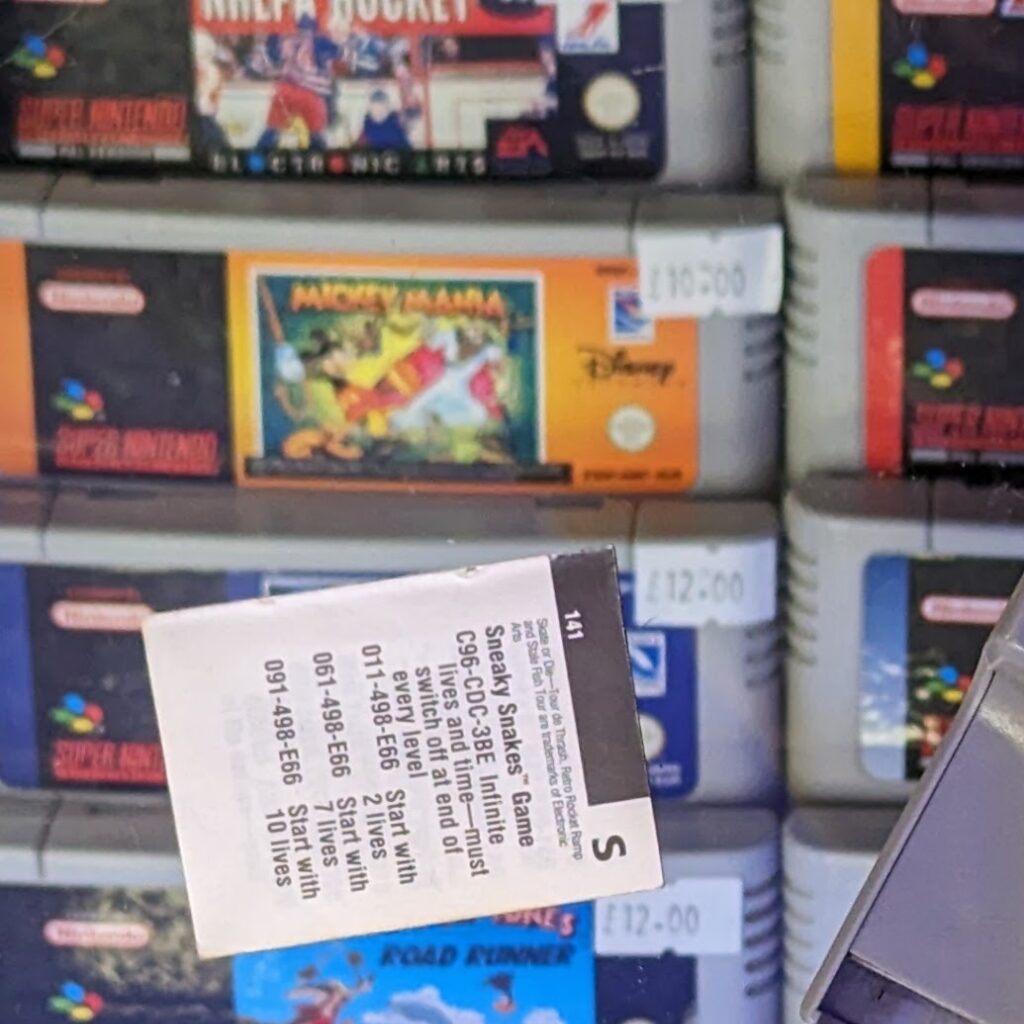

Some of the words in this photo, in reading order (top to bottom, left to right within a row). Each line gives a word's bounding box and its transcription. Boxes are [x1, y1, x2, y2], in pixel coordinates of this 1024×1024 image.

[511, 622, 522, 642] Arts
[524, 620, 535, 639] and
[564, 609, 584, 639] 141
[541, 647, 550, 656] or
[438, 663, 460, 711] lives
[531, 666, 543, 686] Fish
[362, 644, 400, 770] 011-498-E66
[392, 670, 415, 723] every
[415, 666, 442, 730] switch
[535, 689, 545, 711] Tour
[264, 660, 303, 785] 091-498-E66
[313, 652, 351, 778] 061-498-E66
[538, 714, 548, 729] are
[552, 711, 563, 725] de
[427, 737, 449, 761] off
[447, 717, 471, 752] and
[456, 631, 496, 765] C96-CDC-3BE
[480, 775, 506, 844] Infinite
[485, 625, 512, 698] Sneaky
[512, 791, 534, 847] Game
[402, 730, 428, 778] level
[541, 731, 558, 786] trademarks
[432, 768, 452, 787] at
[551, 788, 560, 798] of
[561, 766, 572, 793] Retro
[314, 801, 334, 812] 7
[363, 793, 382, 805] 2
[386, 789, 410, 837] Start
[436, 793, 460, 829] end
[567, 795, 579, 829] Rocket
[265, 809, 287, 834] 10
[288, 804, 313, 853] Start
[337, 797, 361, 845] Start
[366, 812, 387, 860] lives
[552, 799, 568, 847] Electronic
[317, 820, 338, 867] lives
[442, 835, 464, 854] of
[571, 831, 583, 861] Ramp
[592, 834, 626, 861] S
[270, 839, 292, 887] lives
[297, 857, 321, 900] with
[345, 850, 369, 892] with
[394, 843, 418, 884] with
[603, 902, 698, 936] £12.00
[381, 943, 457, 967] ROAD
[466, 943, 576, 967] RUNNER
